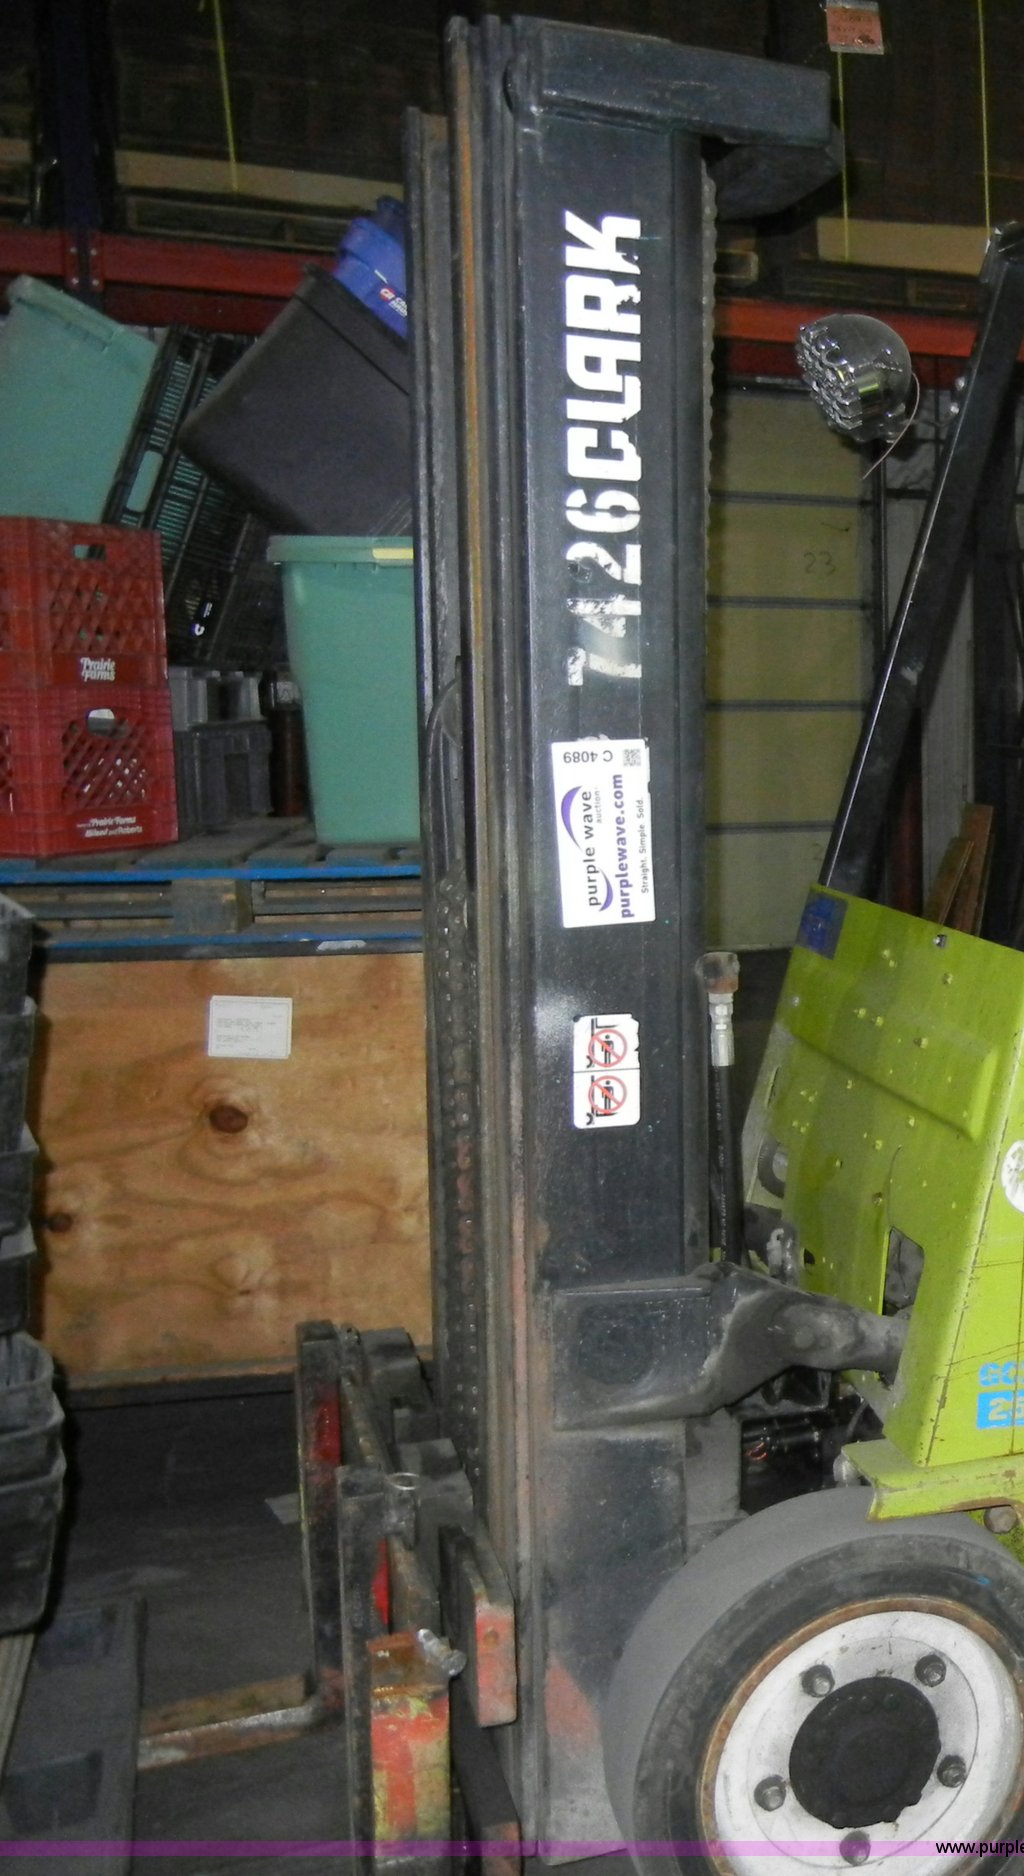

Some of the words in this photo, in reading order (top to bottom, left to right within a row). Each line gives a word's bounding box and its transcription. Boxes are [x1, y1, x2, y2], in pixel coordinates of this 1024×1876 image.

[565, 209, 642, 482] CLARK
[803, 551, 837, 577] 23
[566, 489, 642, 687] 7426
[80, 657, 116, 671] Prairie
[563, 751, 598, 763] 4089
[603, 750, 613, 762] C
[581, 791, 594, 840] wave
[594, 790, 602, 823] auction
[613, 774, 635, 918] purplewave.com
[583, 847, 602, 907] purple
